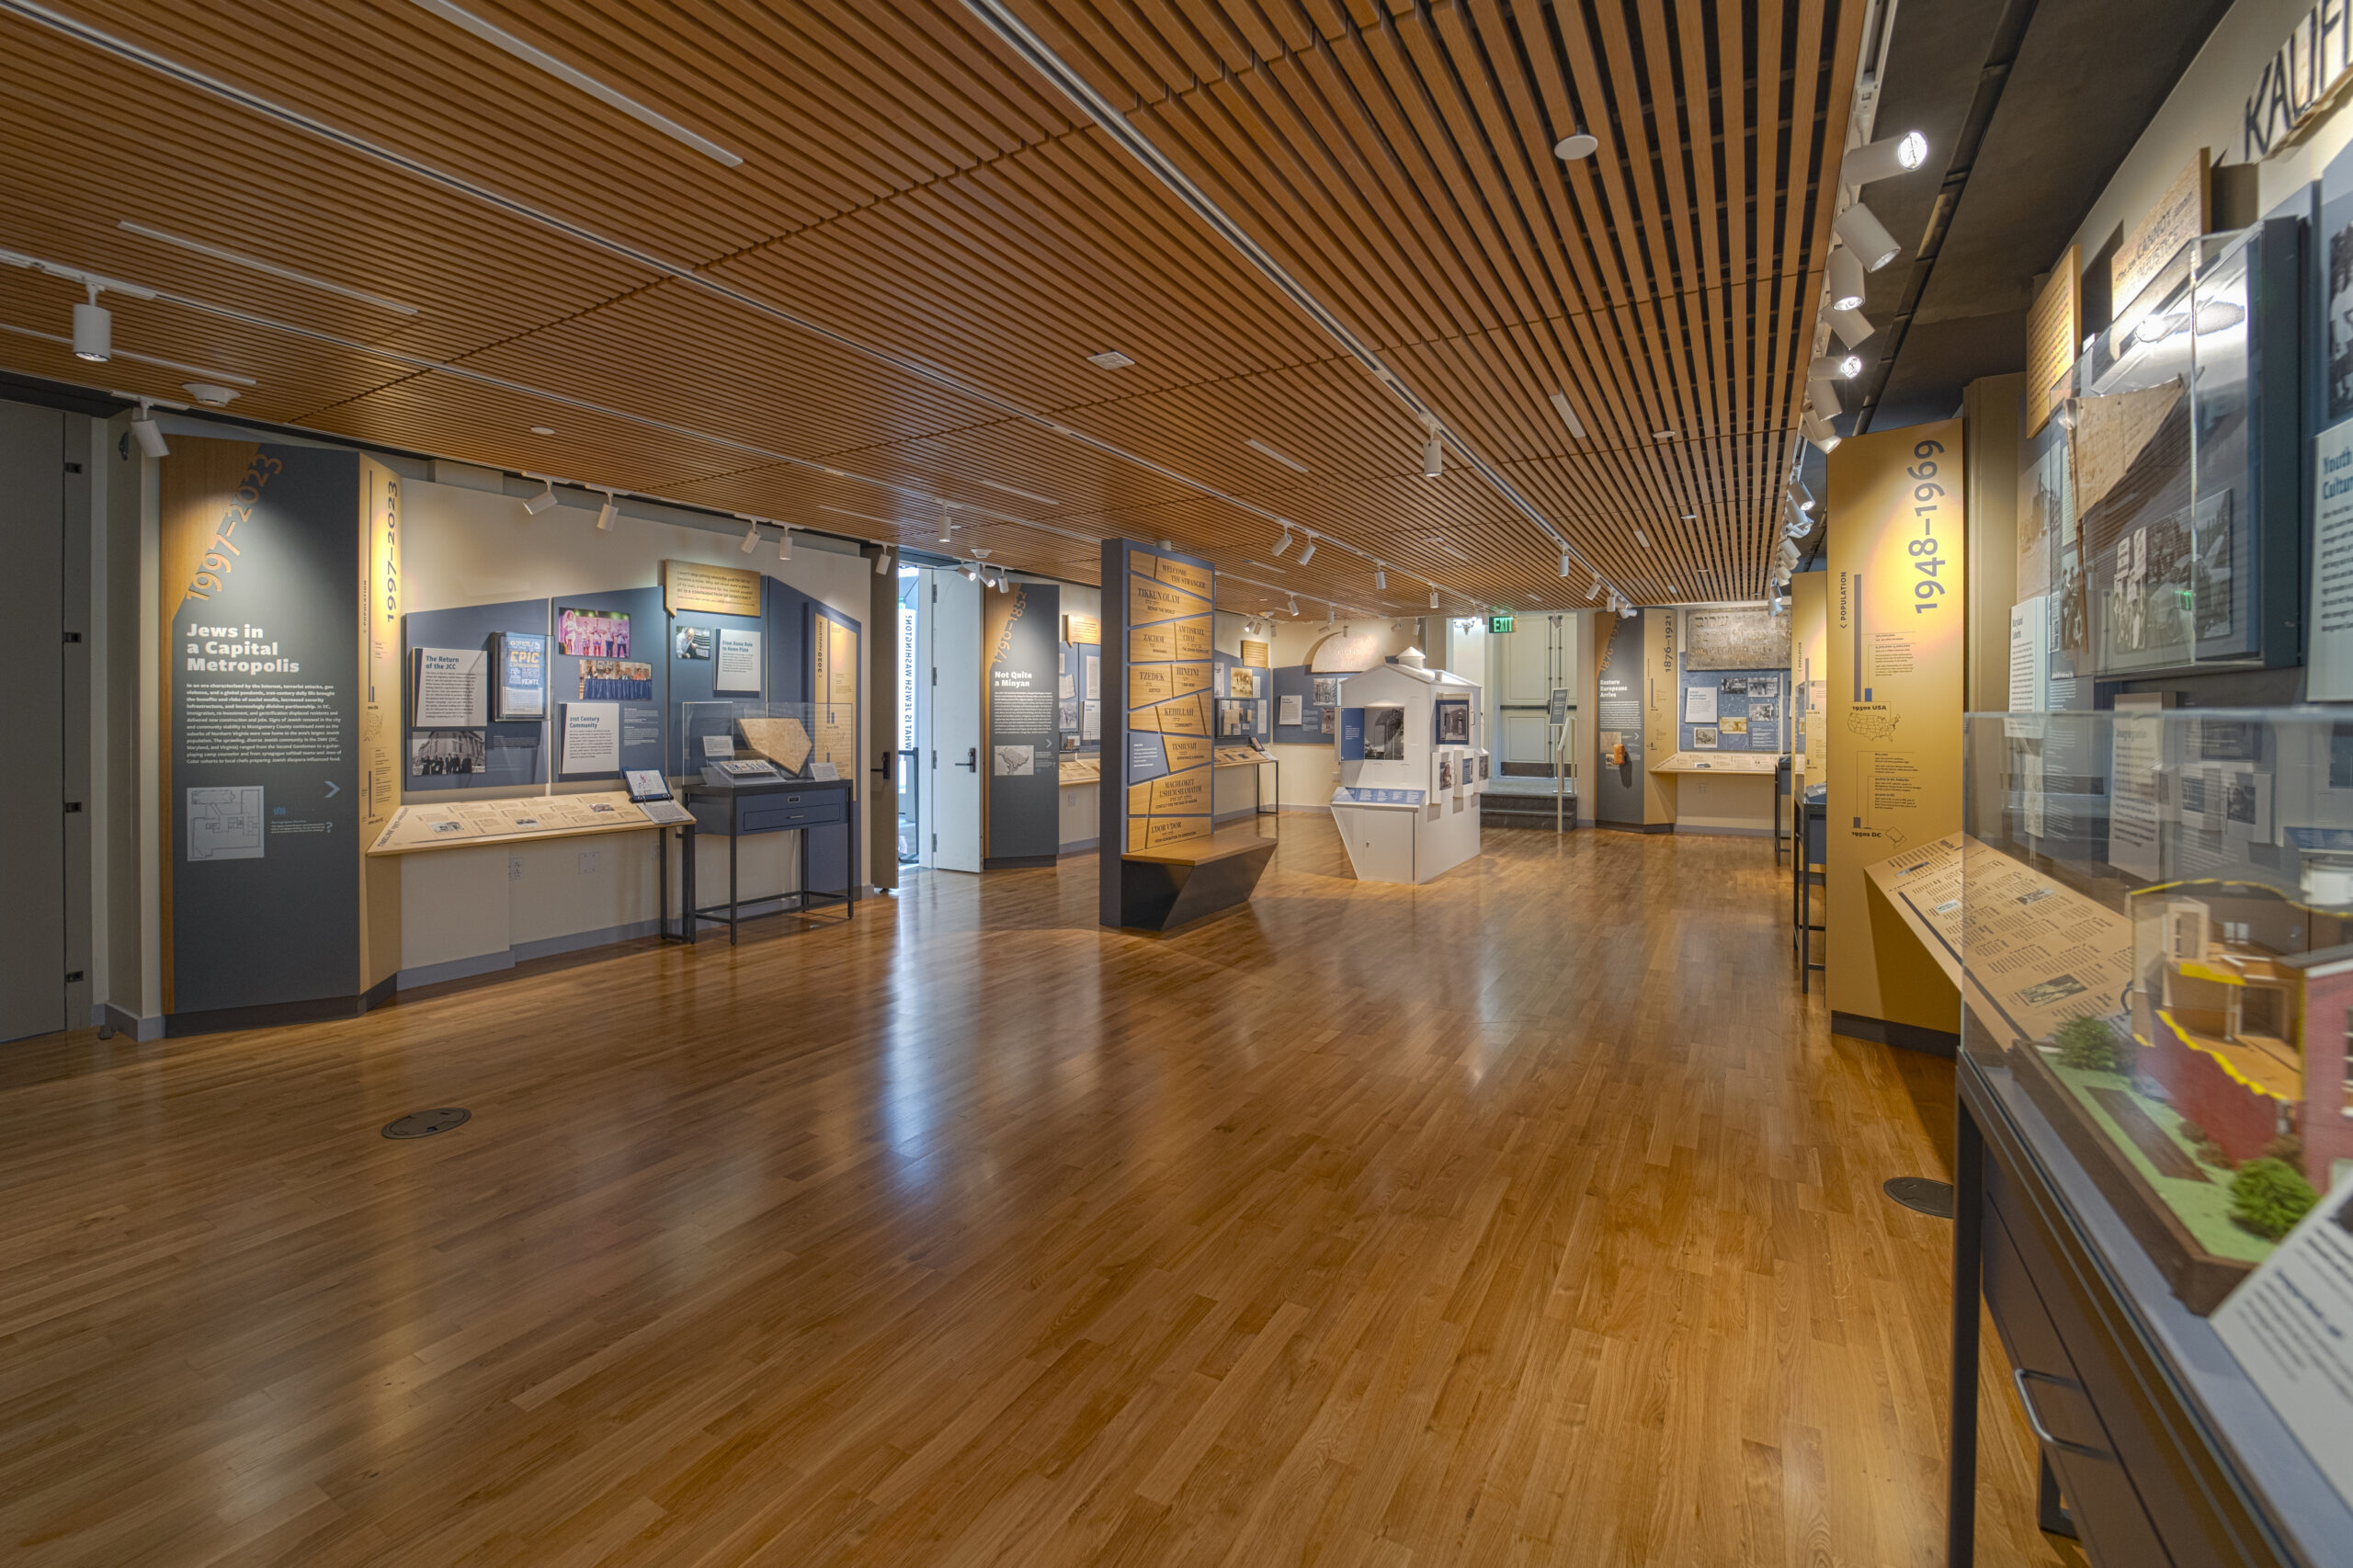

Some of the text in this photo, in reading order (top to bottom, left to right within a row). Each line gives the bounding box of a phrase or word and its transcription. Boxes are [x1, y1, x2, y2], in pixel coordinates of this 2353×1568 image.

[1906, 439, 1945, 614] 1948–1969
[386, 480, 398, 623] 1997–2023
[1162, 564, 1187, 575] WELCOME
[1171, 574, 1206, 589] THE STRANGER
[1138, 587, 1163, 601] TIKKUN
[1164, 594, 1180, 604] OLAM
[187, 624, 264, 638] Jews in
[1494, 618, 1514, 632] EXIT
[187, 641, 278, 658] a Capital
[1664, 615, 1673, 673] 1876–1921
[510, 651, 540, 663] EPIC
[187, 658, 300, 675] Metropolis
[995, 671, 1033, 680] Not Quite
[1140, 671, 1165, 681] TZEDEK
[1001, 679, 1029, 688] Minyan
[1165, 708, 1194, 716] KEHILLAH
[1172, 743, 1197, 751] TESHUVAH
